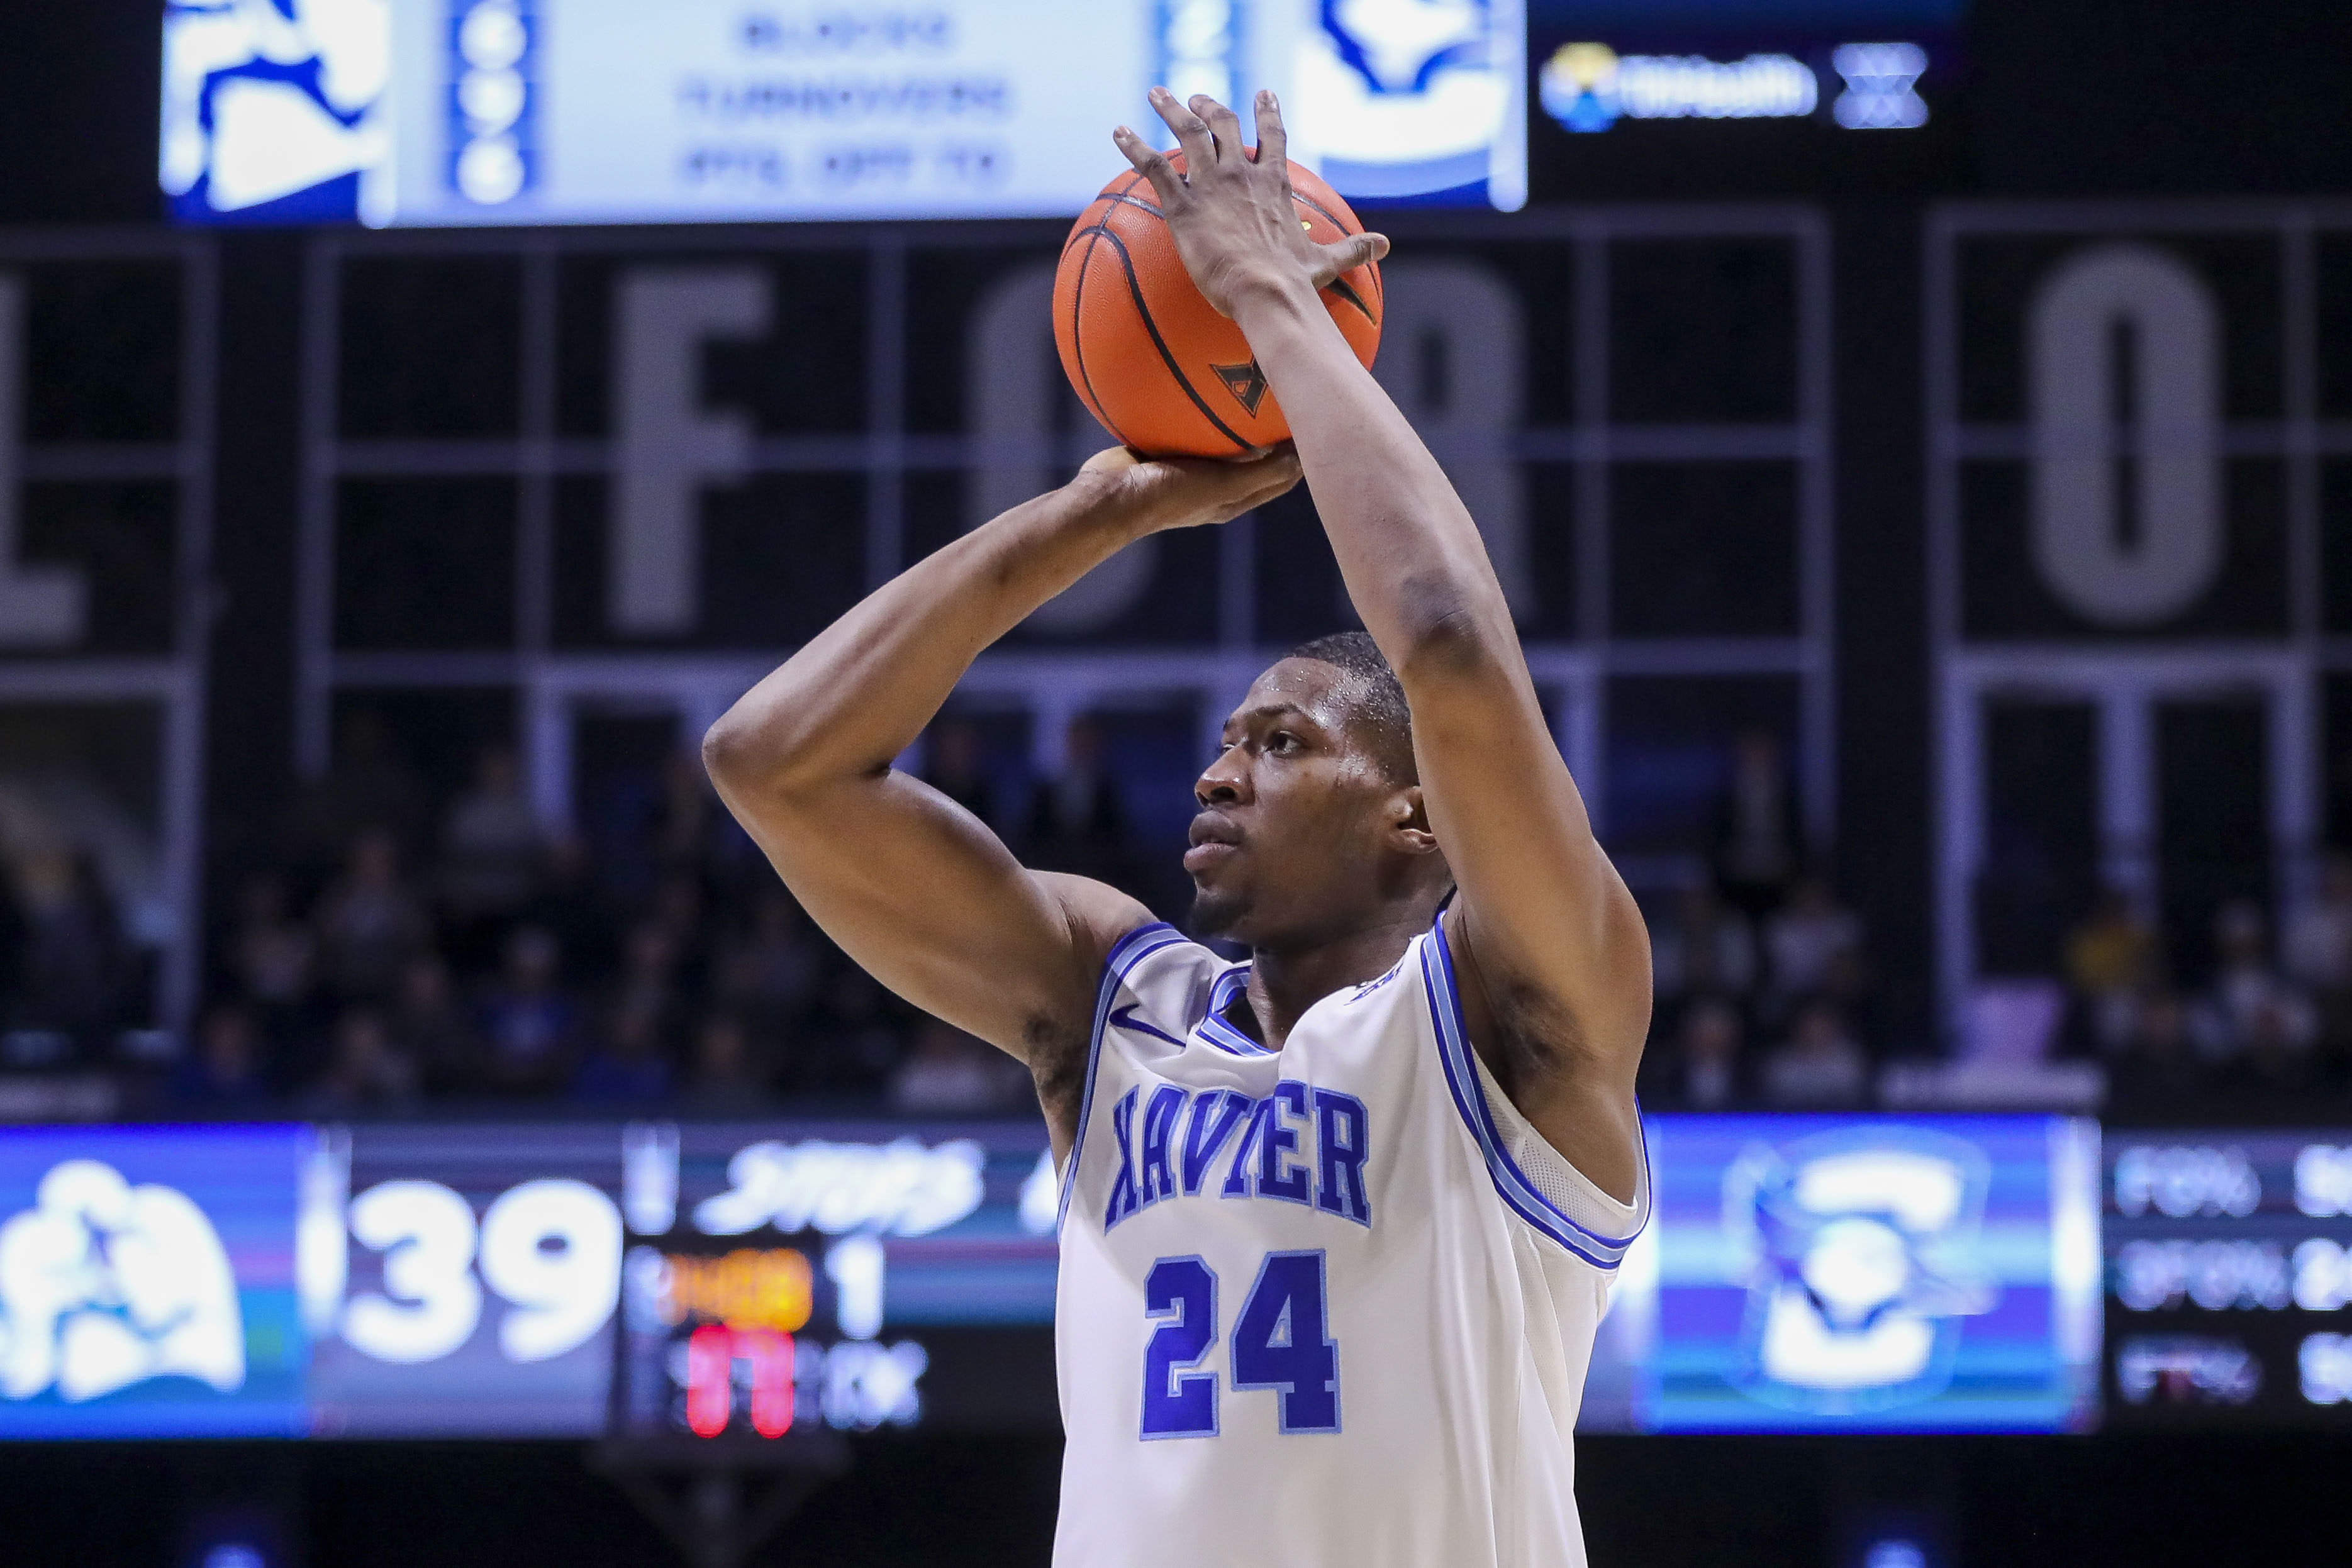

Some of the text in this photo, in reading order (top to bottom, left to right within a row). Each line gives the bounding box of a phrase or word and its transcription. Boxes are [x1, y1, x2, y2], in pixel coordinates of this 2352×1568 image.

[1105, 1079, 1371, 1237] XAVIER
[340, 1177, 623, 1364] 39
[1139, 1248, 1342, 1442] 24
